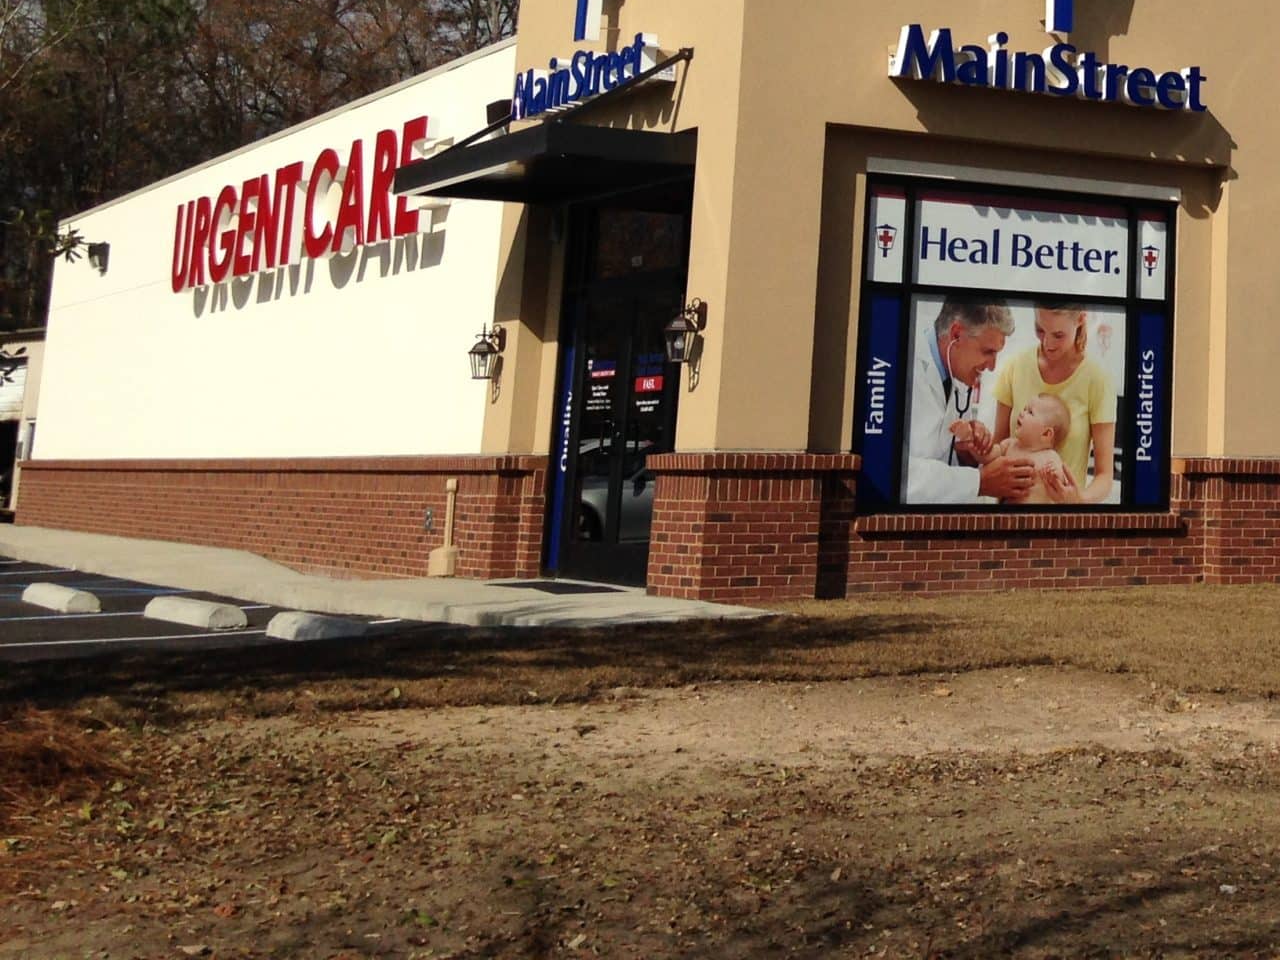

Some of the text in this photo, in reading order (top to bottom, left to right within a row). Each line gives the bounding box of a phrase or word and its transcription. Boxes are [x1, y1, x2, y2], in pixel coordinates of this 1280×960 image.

[512, 32, 646, 120] MainStreet
[899, 23, 1207, 112] MainStreet
[171, 116, 428, 293] URGENT CARE
[920, 226, 1121, 275] Heal Better.
[865, 356, 891, 435] Family
[1136, 349, 1155, 462] Pediatrics
